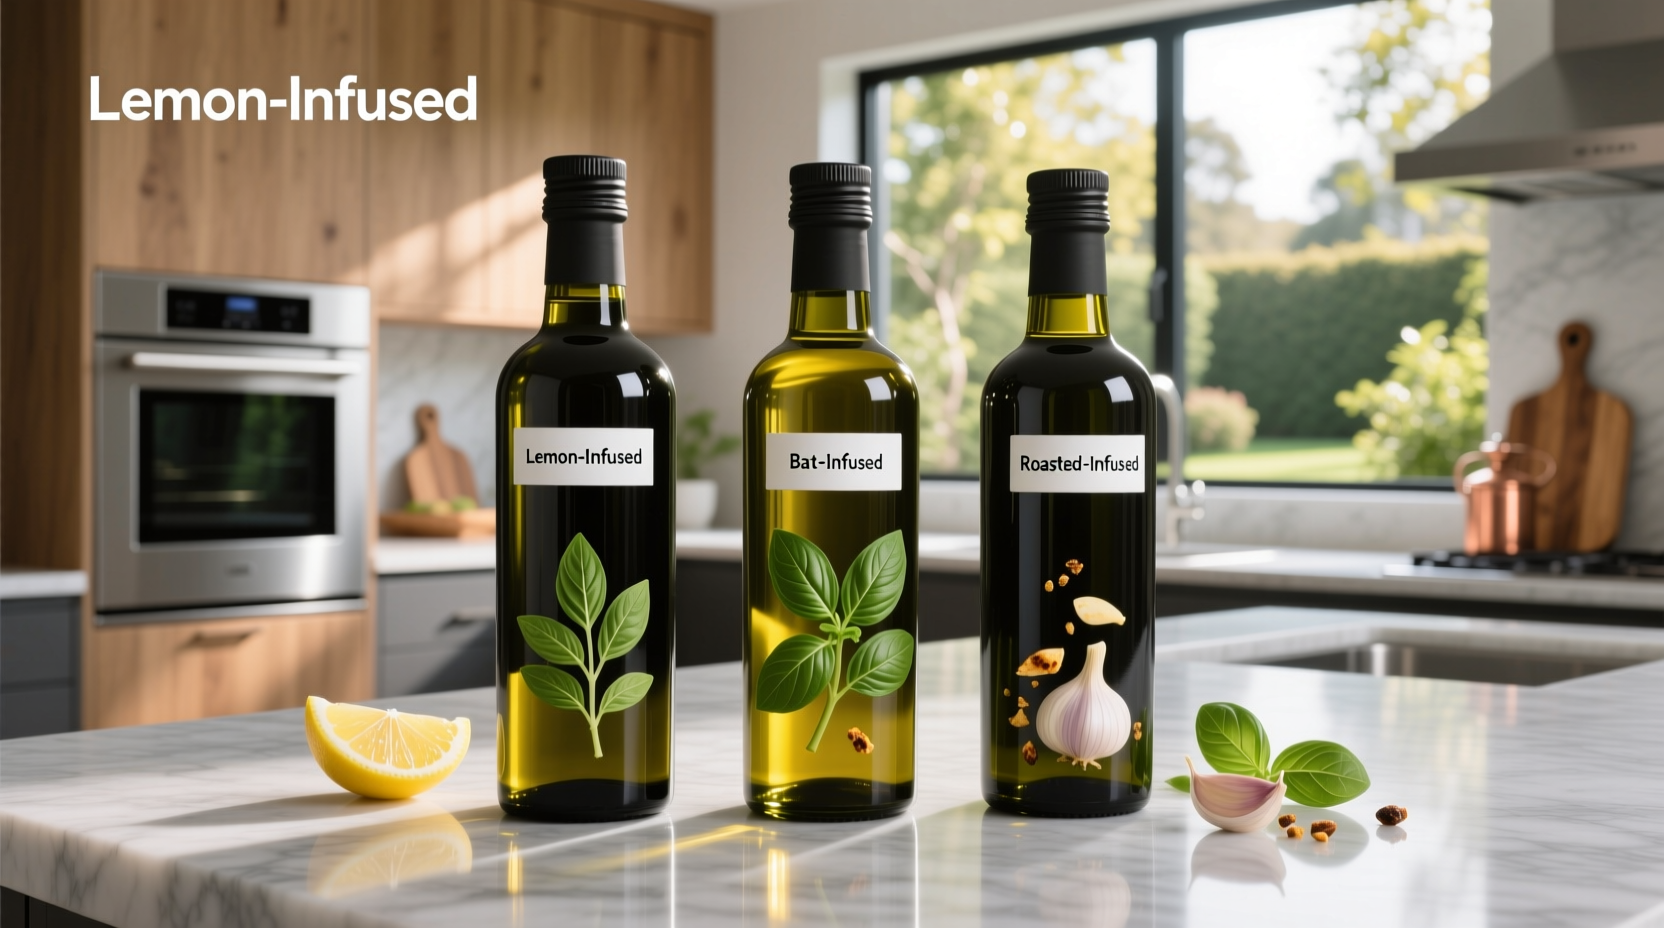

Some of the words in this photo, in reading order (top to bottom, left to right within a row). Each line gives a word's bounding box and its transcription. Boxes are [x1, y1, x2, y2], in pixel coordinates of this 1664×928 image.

[526, 447, 642, 465] Lemon-Infused
[789, 452, 883, 470] Bat-Infused
[1020, 454, 1139, 472] Roasted-Infused
